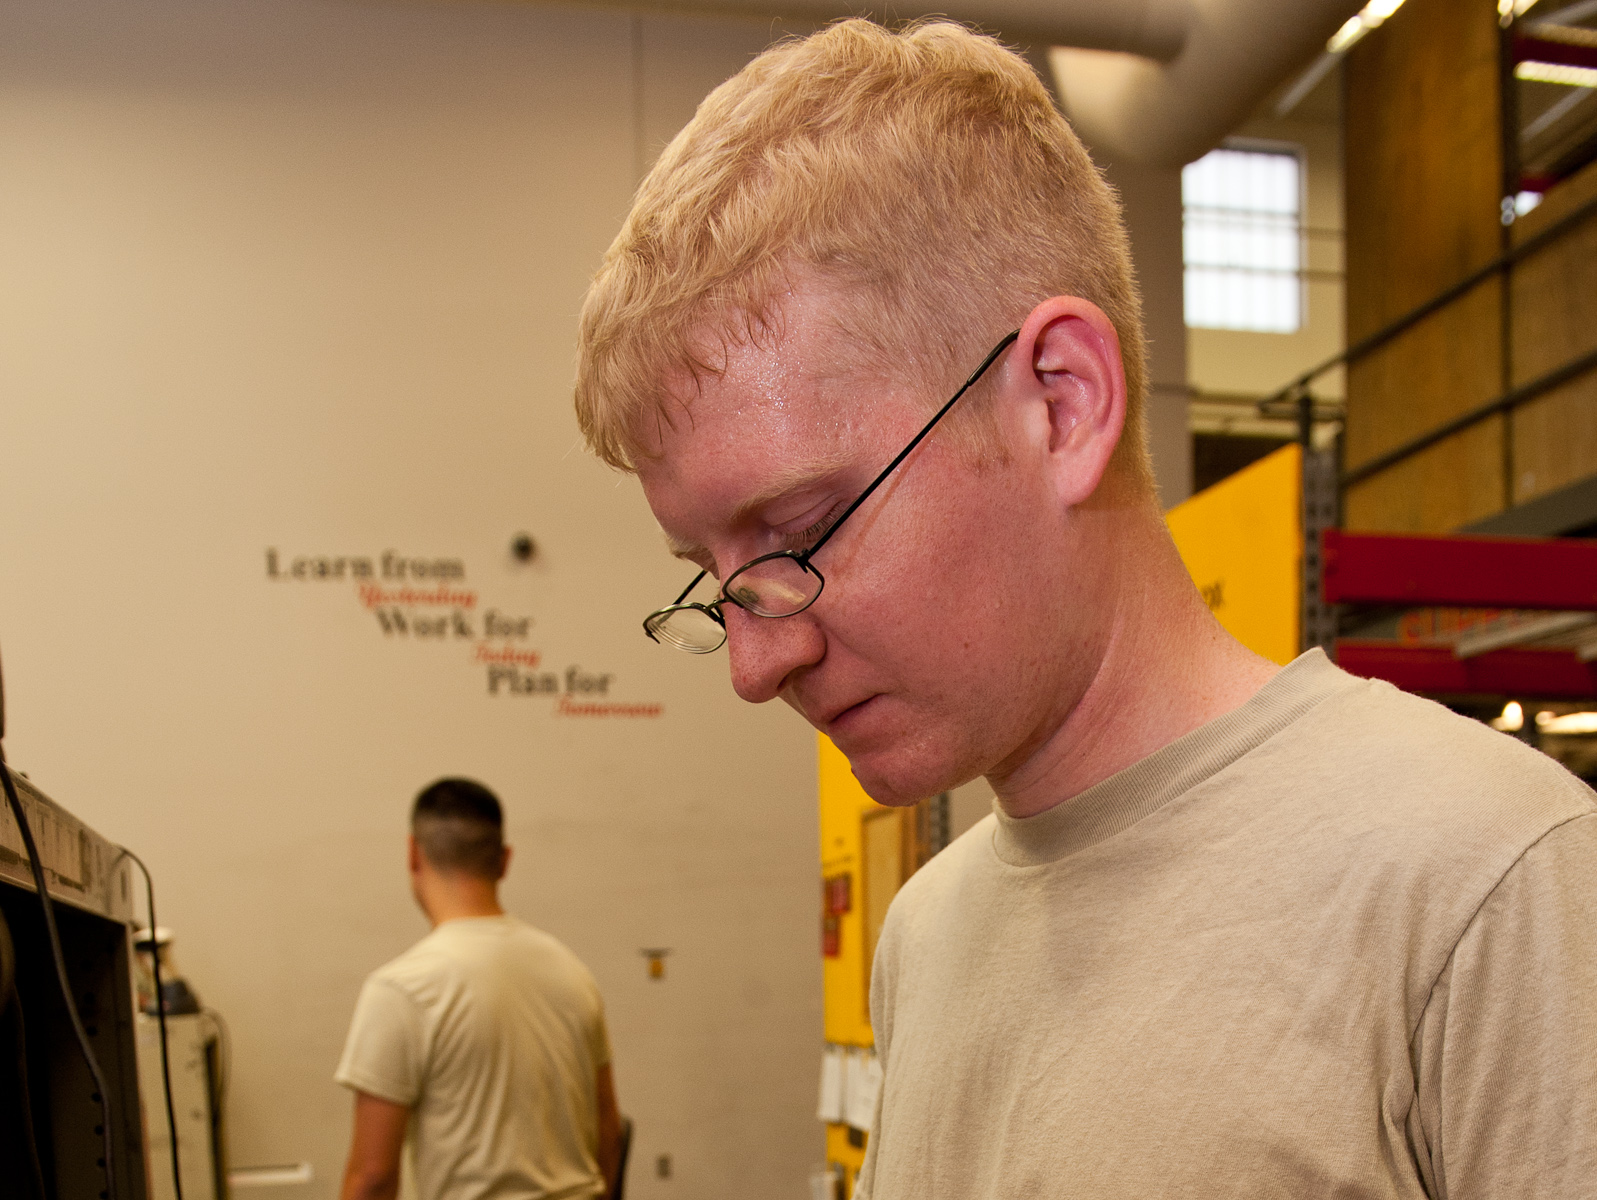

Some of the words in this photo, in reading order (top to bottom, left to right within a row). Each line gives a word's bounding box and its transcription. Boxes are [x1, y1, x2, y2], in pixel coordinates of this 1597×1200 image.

[265, 546, 374, 581] Learn
[379, 548, 466, 581] from
[376, 607, 474, 638] Work
[484, 608, 533, 638] for
[487, 664, 559, 694] Plan
[564, 664, 613, 694] for
